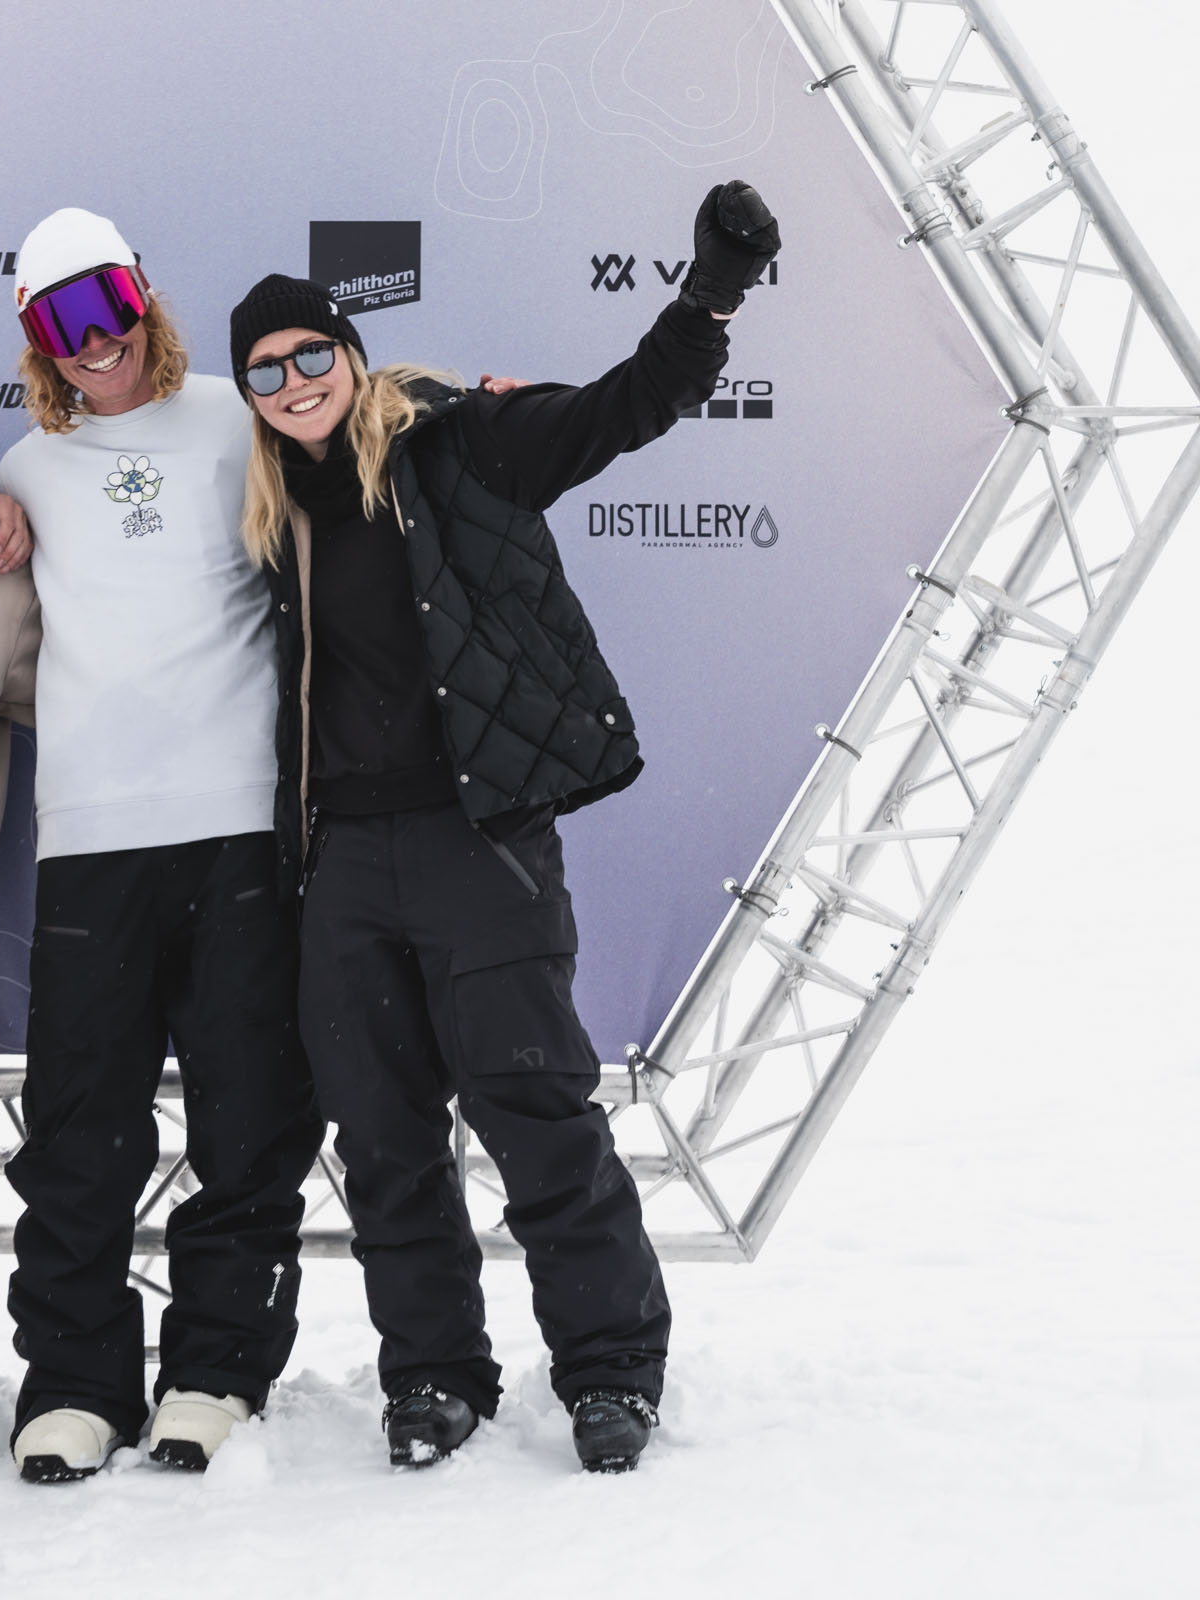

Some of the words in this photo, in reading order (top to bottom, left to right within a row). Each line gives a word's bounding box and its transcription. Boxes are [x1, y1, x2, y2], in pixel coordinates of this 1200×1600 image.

[329, 269, 415, 297] chilthorn
[363, 295, 381, 306] Piz
[383, 288, 415, 303] Gloria
[589, 503, 750, 538] DISTILLERY
